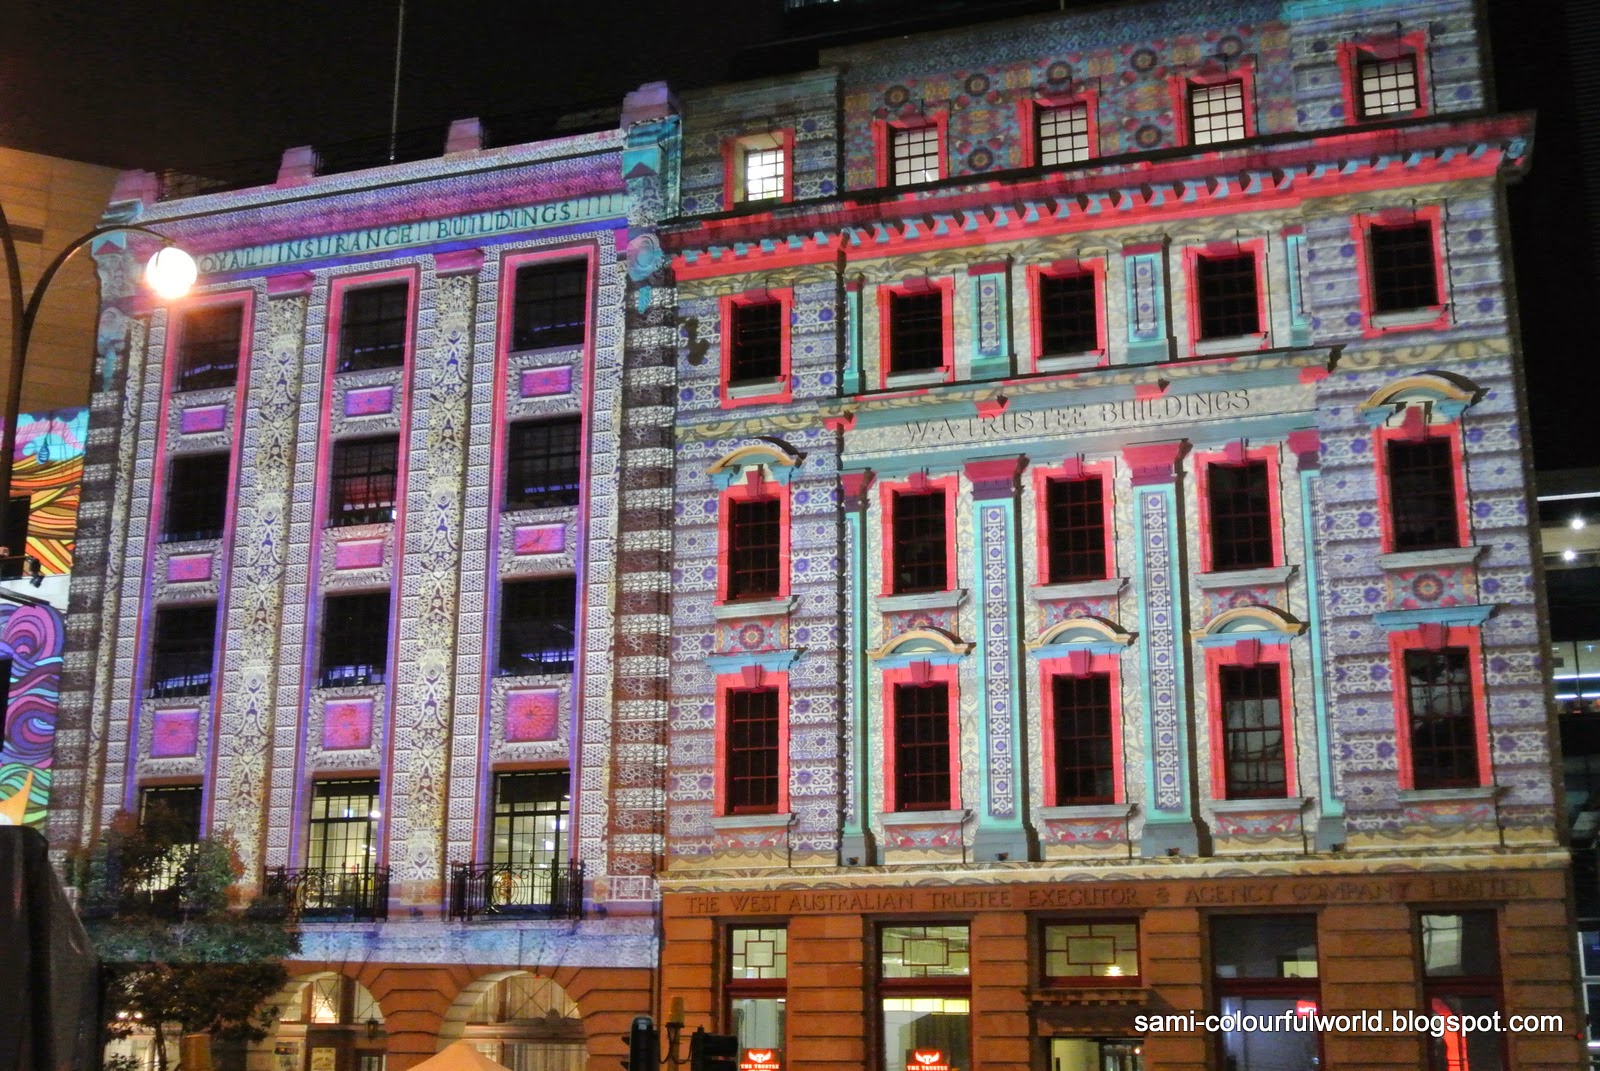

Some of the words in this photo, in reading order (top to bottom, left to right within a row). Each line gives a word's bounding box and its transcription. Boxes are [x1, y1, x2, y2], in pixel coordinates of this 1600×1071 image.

[199, 248, 257, 274] OYAL
[277, 225, 412, 262] INSURANCE
[437, 206, 570, 238] BUILDINGS
[1102, 389, 1250, 422] BUILDINGS
[686, 894, 720, 914] THE
[729, 893, 778, 912] WEST
[788, 892, 914, 911] AUSTRALIAN
[929, 890, 1012, 909] TRUSTEE
[1028, 882, 1138, 908] EXECUTOR
[1185, 882, 1279, 903] AGENCY
